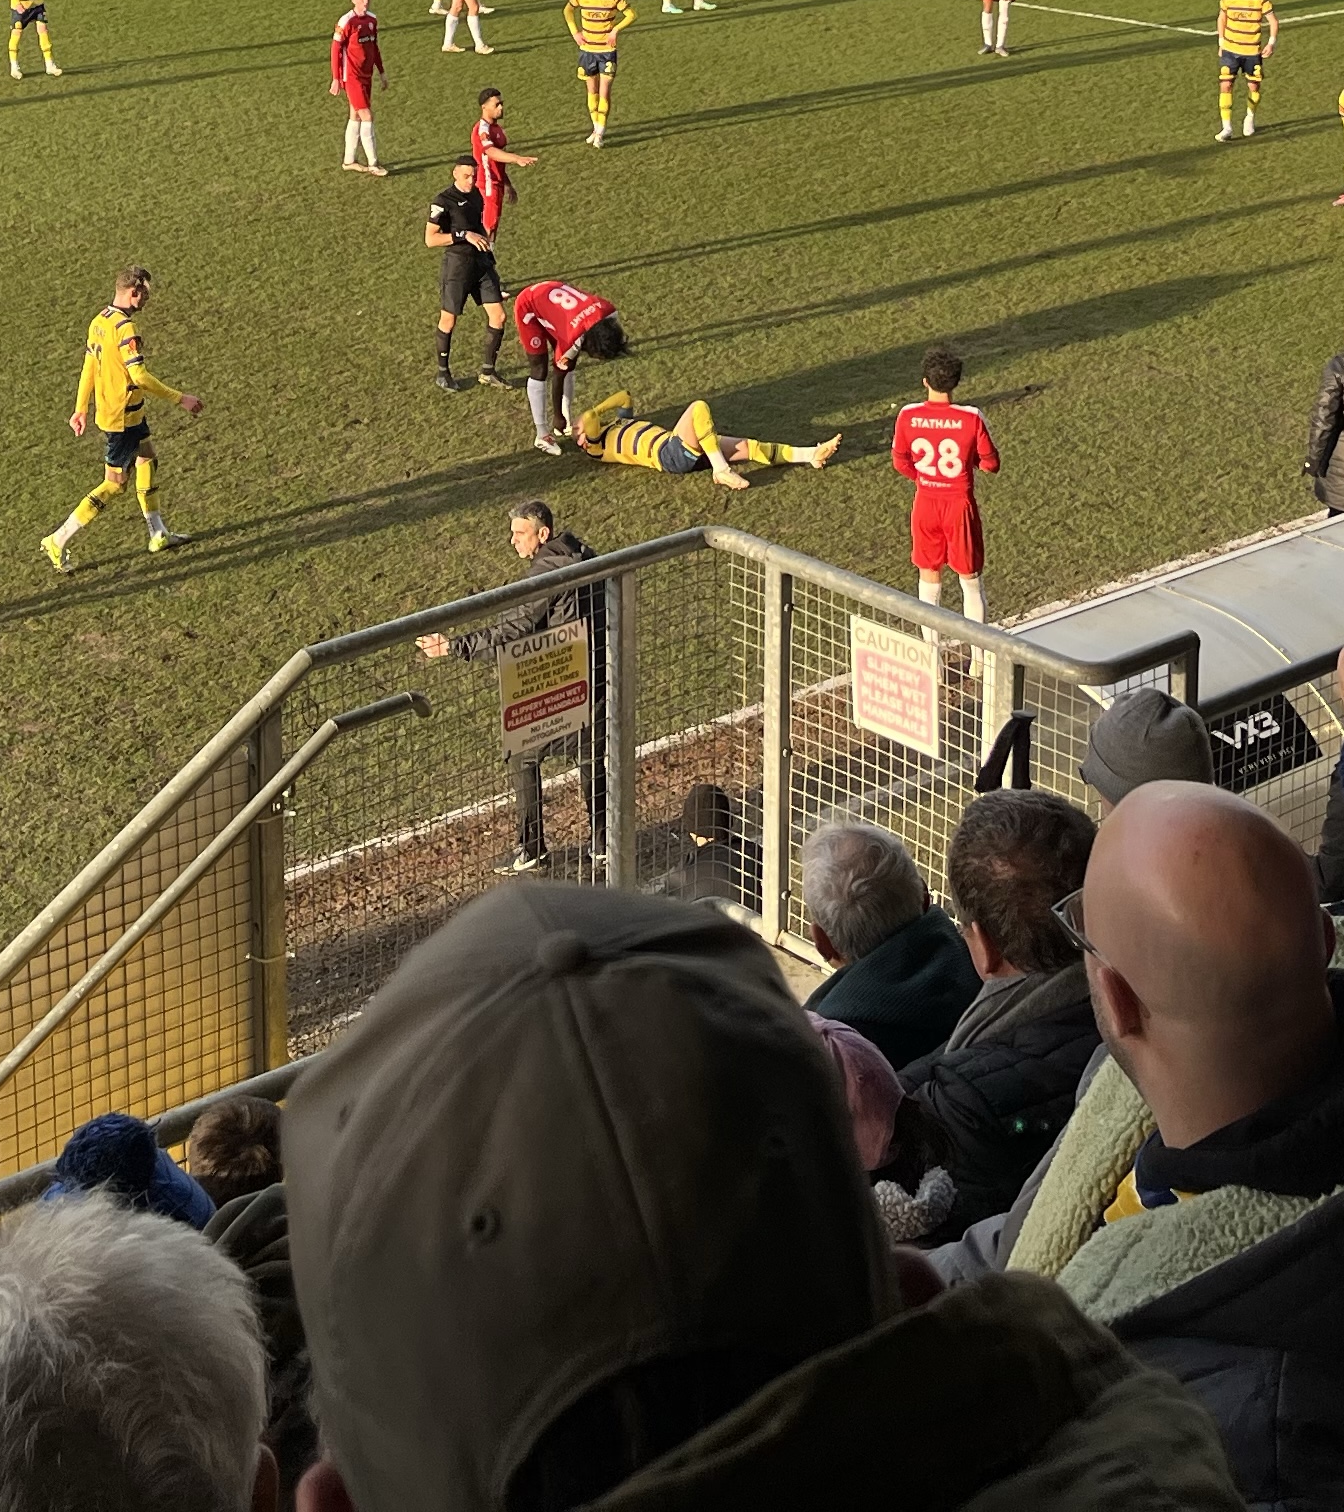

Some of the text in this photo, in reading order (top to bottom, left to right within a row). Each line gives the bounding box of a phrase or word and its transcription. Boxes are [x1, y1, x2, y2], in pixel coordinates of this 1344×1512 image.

[548, 284, 588, 310] 18
[910, 417, 962, 430] STATHAM
[910, 437, 963, 479] 28
[511, 625, 579, 659] CAUTION
[855, 626, 932, 670] CAUTION
[515, 645, 574, 671] STEPS & YELLOW
[517, 654, 573, 679] HATCHED AREAS
[866, 655, 921, 685] SLIPPERY
[512, 670, 580, 700] CLEAR AT ALL TIMES
[521, 664, 570, 687] MUST BE KEPT
[861, 670, 927, 706] WHEN WET
[511, 699, 544, 718] SLIPPERY
[544, 691, 566, 706] WHEN
[547, 693, 586, 714] HANDRAILS
[861, 685, 928, 722] PLEASE USE
[530, 715, 564, 734] NO FLASH
[862, 702, 928, 738] HANDRAILS
[522, 721, 573, 747] PHOTOGRAPHY
